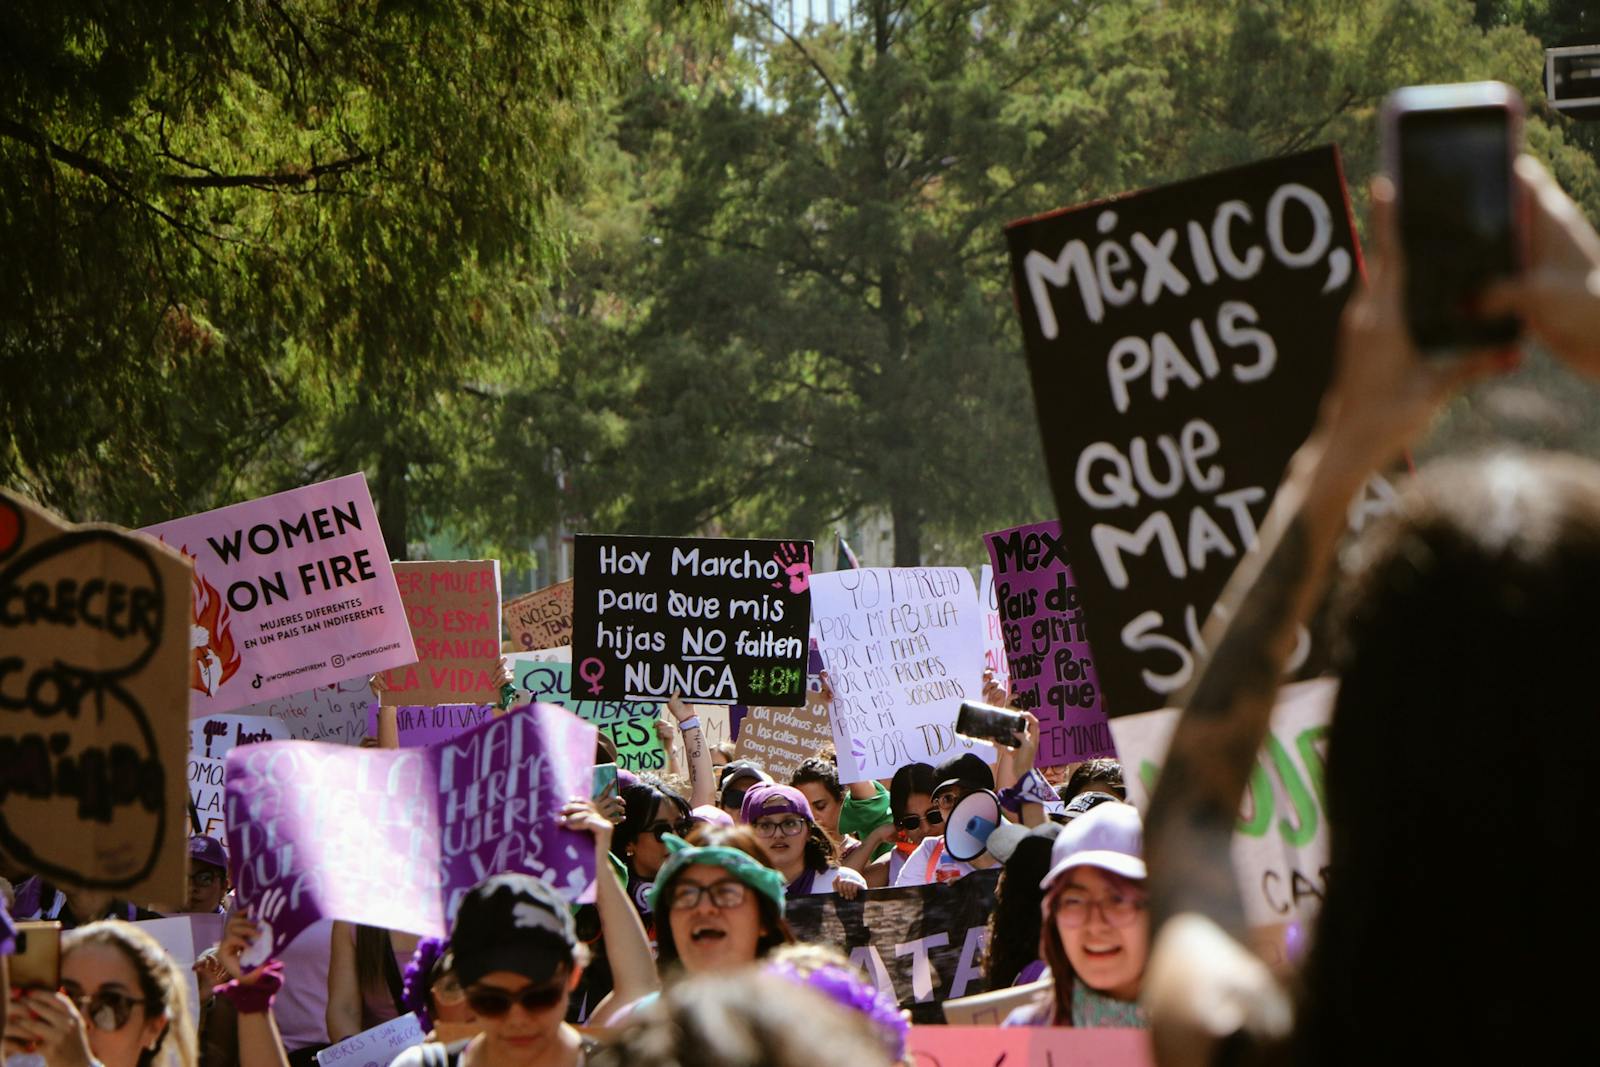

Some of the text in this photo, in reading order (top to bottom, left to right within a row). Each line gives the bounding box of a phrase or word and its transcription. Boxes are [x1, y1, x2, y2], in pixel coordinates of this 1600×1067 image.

[1107, 300, 1277, 413] PAIS
[206, 501, 362, 565] WOMEN
[227, 549, 376, 612] ON FIRE
[671, 547, 779, 580] Marcho
[598, 589, 658, 615] para
[729, 594, 784, 622] mis
[839, 569, 880, 610] YO
[888, 568, 960, 603] MARCHO
[244, 638, 258, 649] EN
[260, 634, 275, 646] UN
[301, 622, 321, 634] TAN
[324, 605, 385, 629] INDIFERENTE
[260, 598, 363, 632] MUJERES DIFERENTES
[818, 612, 860, 641] POR
[890, 601, 959, 634] ABUELA
[597, 621, 666, 660] hijas
[682, 626, 727, 656] NO
[735, 631, 802, 659] falten
[823, 643, 862, 671] POR
[385, 666, 420, 692] LA
[429, 665, 497, 694] VIDA
[625, 661, 739, 699] NUNCA
[828, 671, 862, 694] POR
[833, 695, 868, 717] POR
[904, 678, 966, 706] SOBRINAS
[1046, 682, 1096, 721] que
[836, 714, 873, 737] POR
[866, 729, 916, 767] POR
